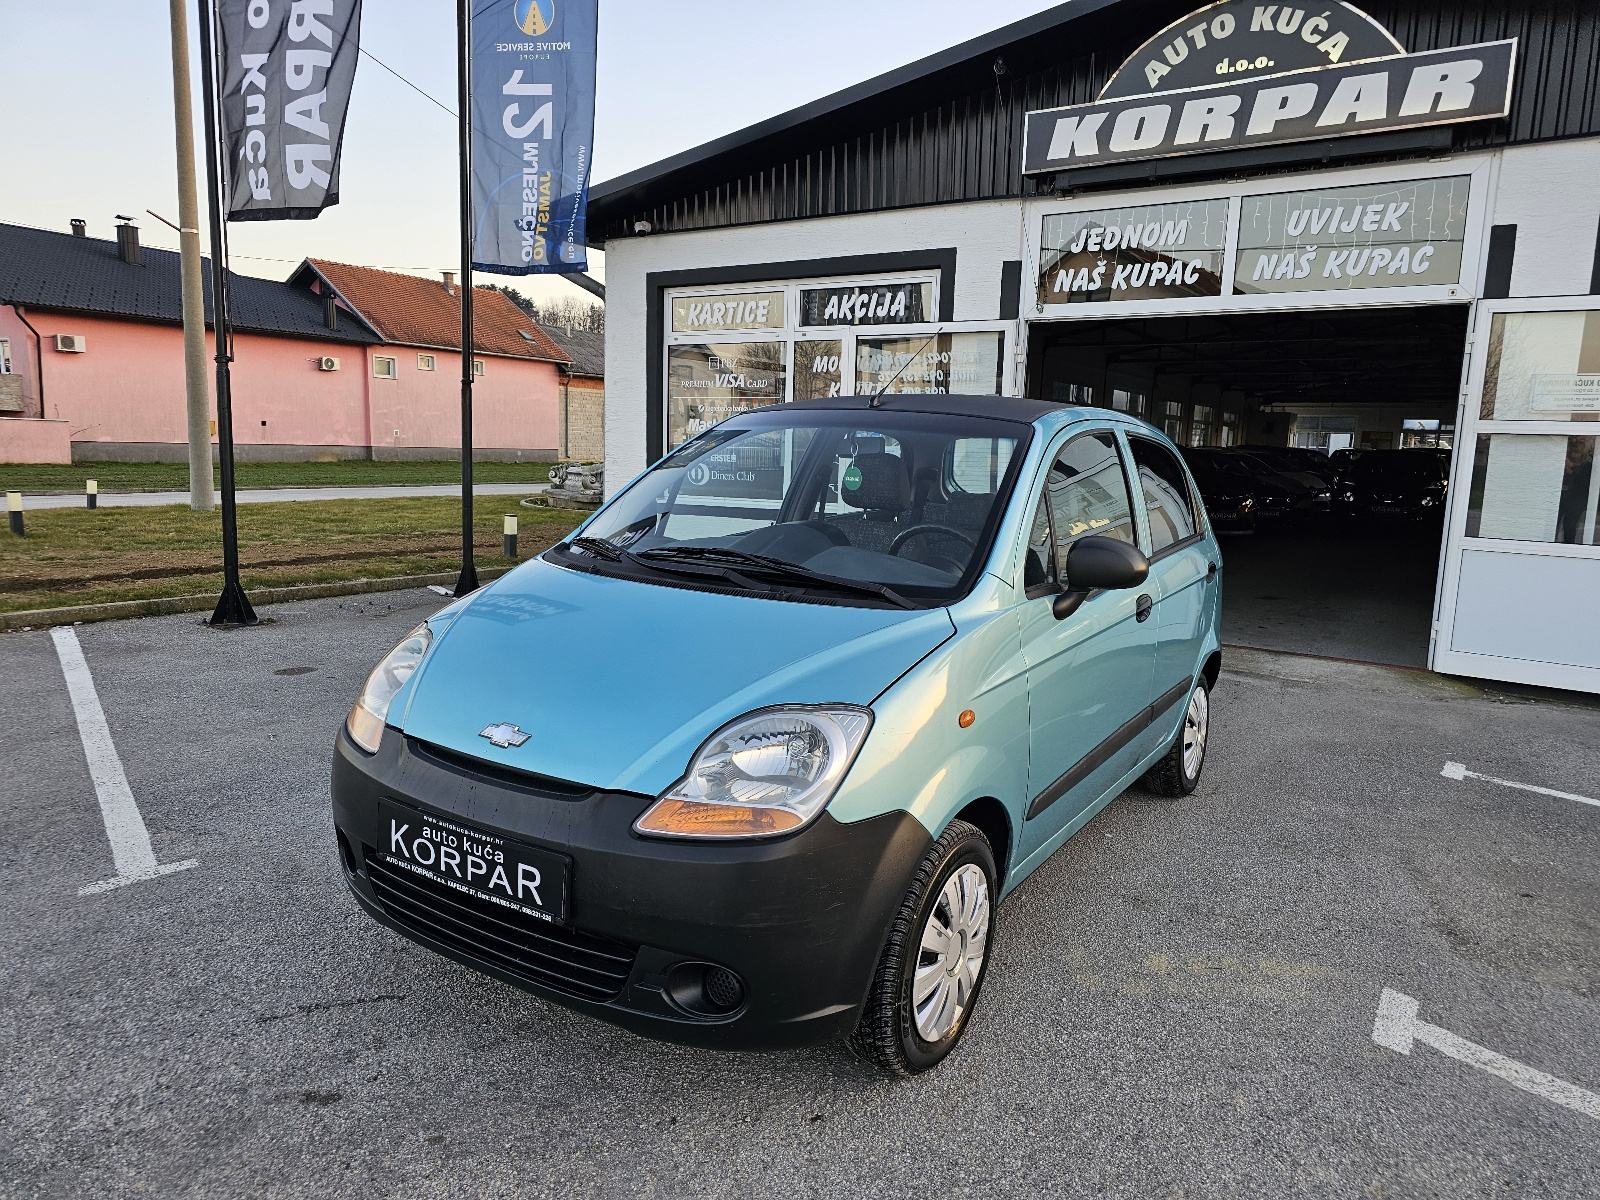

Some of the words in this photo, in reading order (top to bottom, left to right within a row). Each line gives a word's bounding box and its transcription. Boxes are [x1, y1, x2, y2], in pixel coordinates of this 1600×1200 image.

[1143, 12, 1236, 89] AUTO
[1249, 3, 1352, 64] KUĆA
[1215, 54, 1274, 75] d.o.o.
[1046, 59, 1483, 161] KORPAR
[1070, 219, 1188, 255] JEDNOM
[1287, 201, 1409, 238] UVIJEK
[1053, 259, 1108, 294] NAŠ
[1114, 258, 1202, 291] KUPAC
[1252, 247, 1314, 282] NAŠ
[1322, 244, 1434, 278] KUPAC
[687, 299, 770, 327] KARTICE
[823, 290, 906, 320] AKCIJA
[714, 373, 746, 388] VISA
[746, 379, 768, 388] CARD
[710, 454, 730, 463] ERSTE
[711, 470, 735, 481] Diners
[736, 471, 755, 482] Club
[390, 818, 543, 906] KORPAR
[422, 826, 458, 848] auto
[463, 836, 504, 864] kuća
[411, 864, 434, 881] KORPAR
